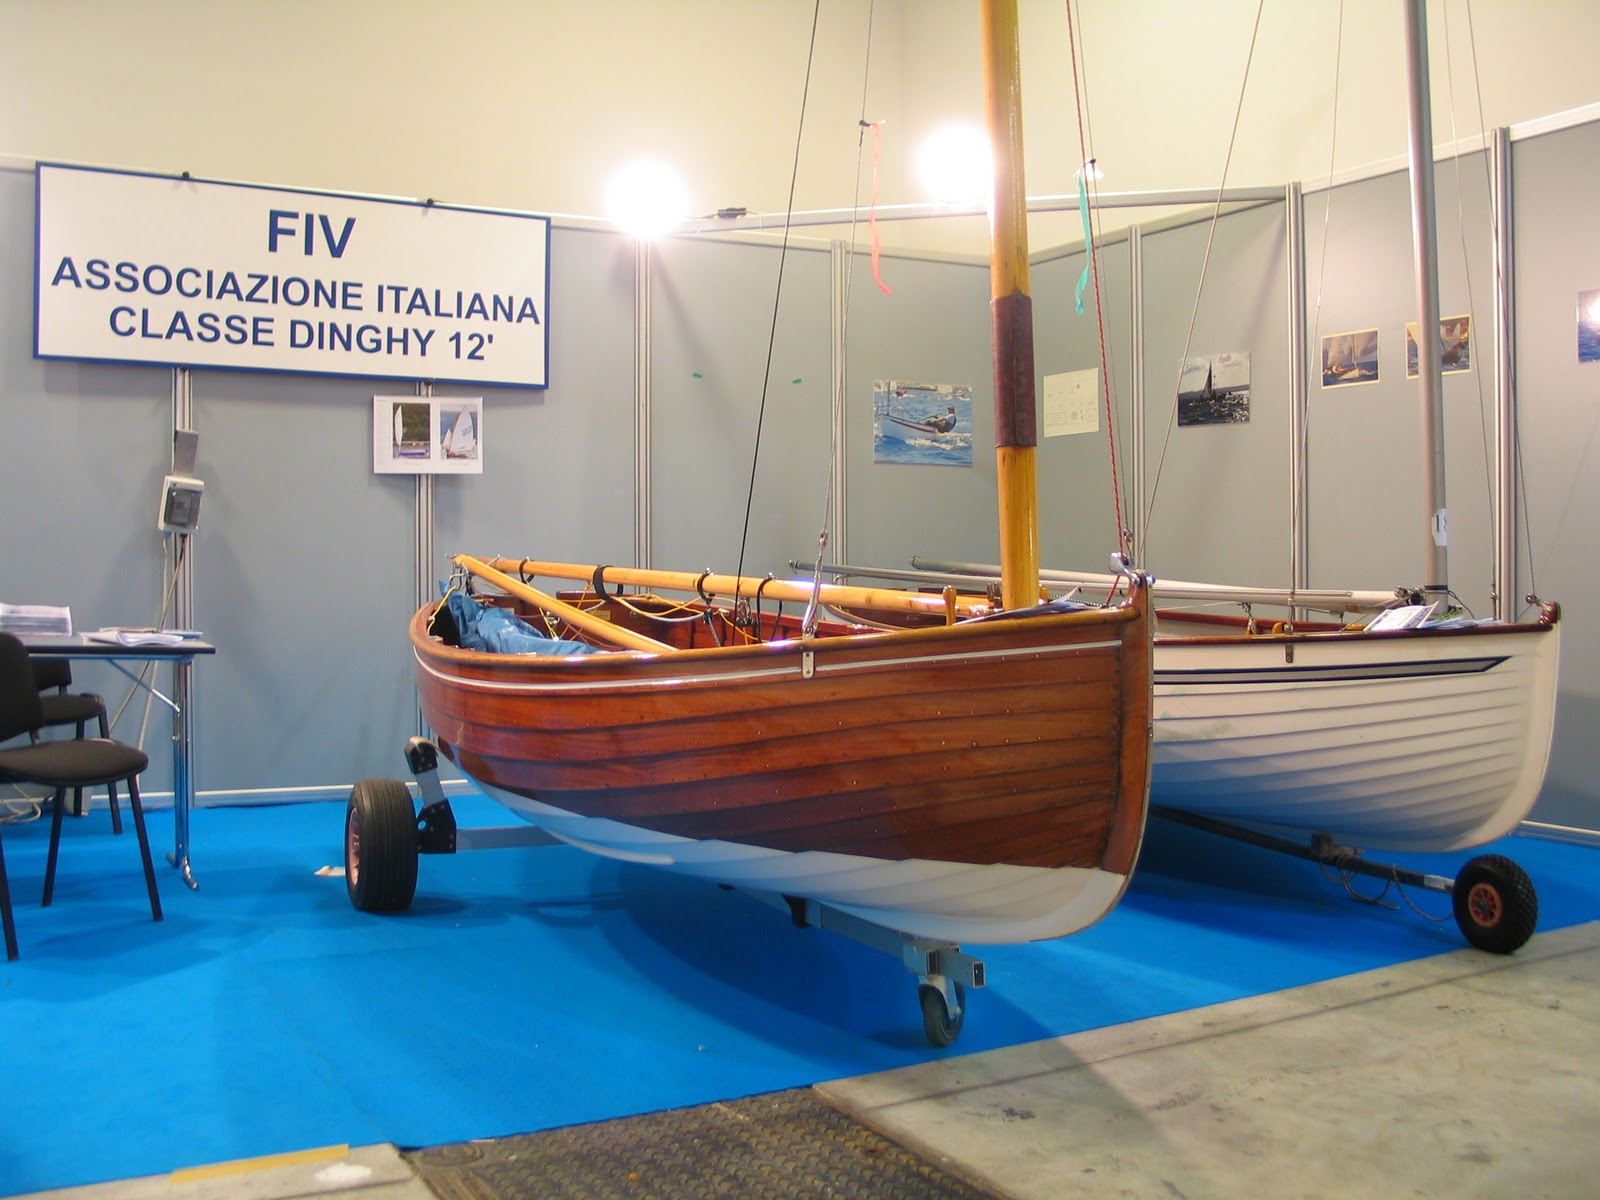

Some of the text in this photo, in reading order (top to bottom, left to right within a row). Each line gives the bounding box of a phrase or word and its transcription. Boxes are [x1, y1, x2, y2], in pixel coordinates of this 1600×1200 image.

[268, 209, 357, 258] FIV
[51, 256, 540, 325] ASSOCIAZIONE ITALIANA
[109, 306, 494, 361] CLASSE DINGHY 12'
